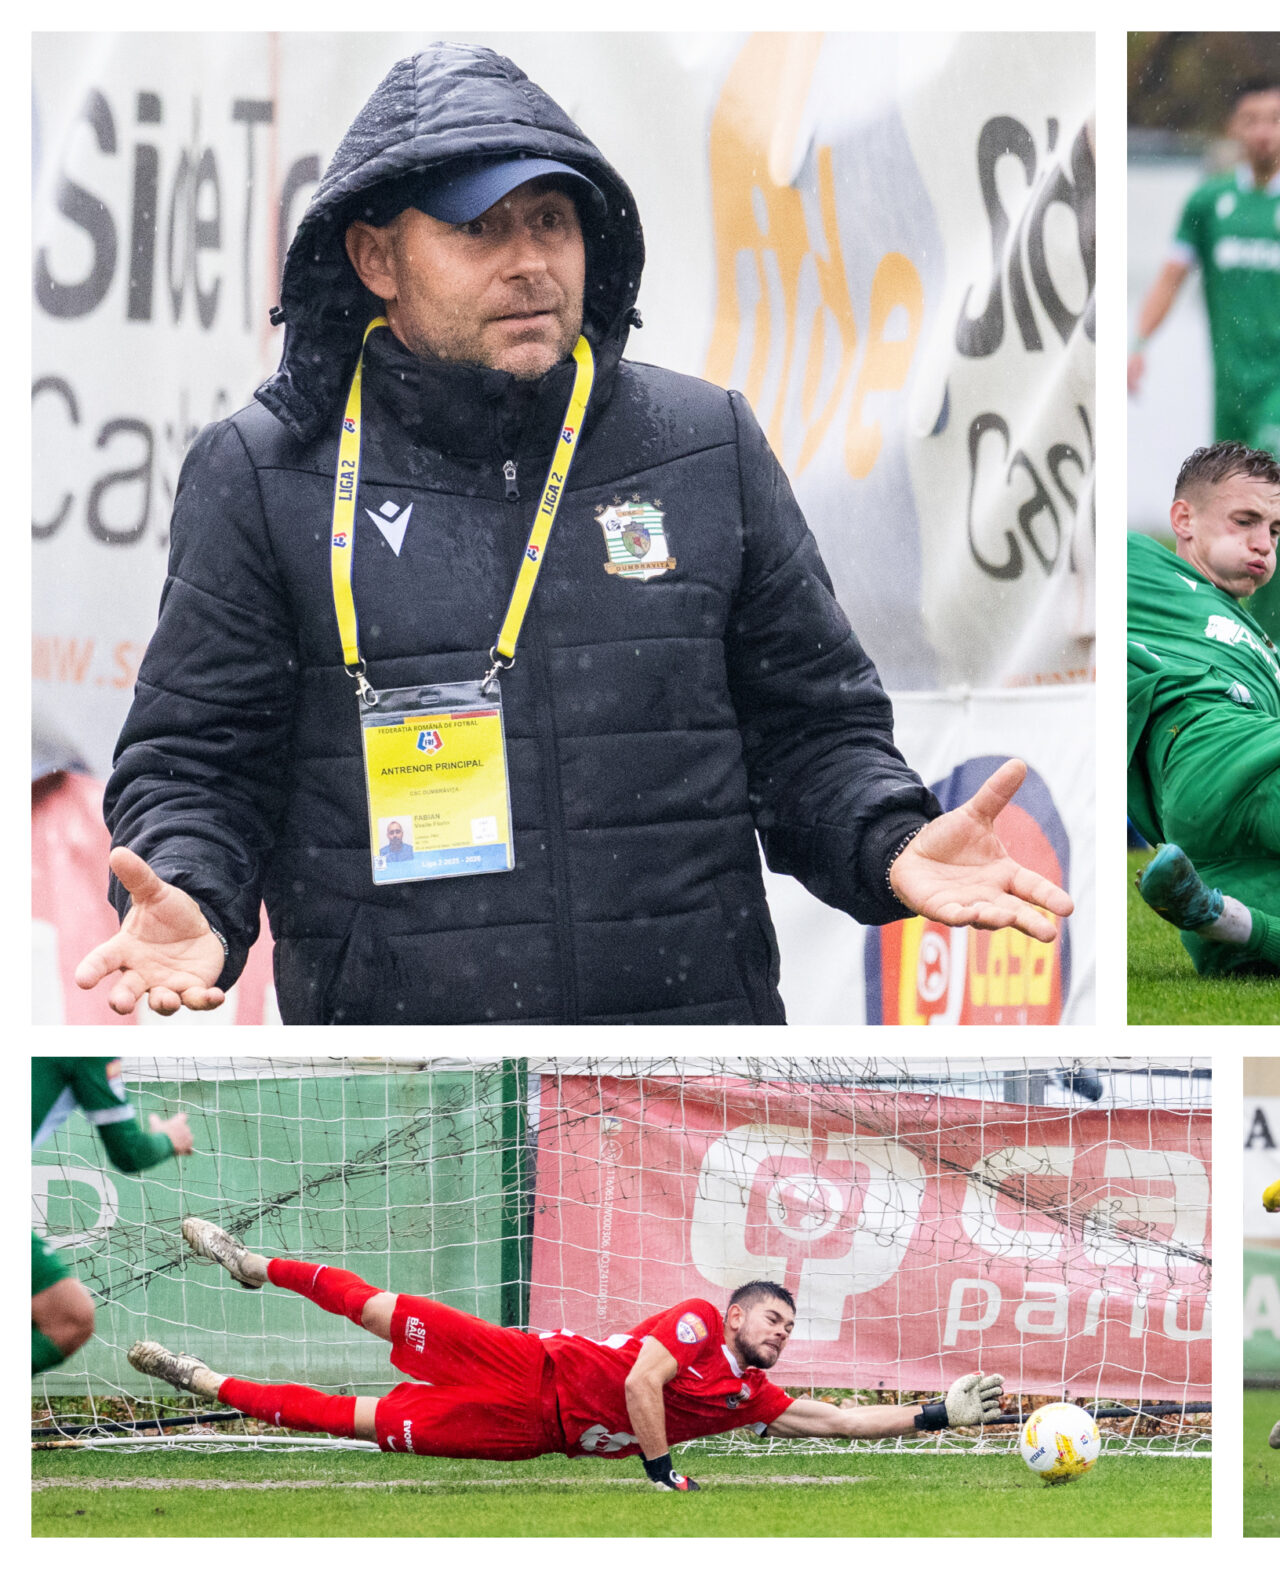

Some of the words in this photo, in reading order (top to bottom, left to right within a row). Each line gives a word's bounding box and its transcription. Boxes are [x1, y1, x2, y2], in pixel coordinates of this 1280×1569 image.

[342, 460, 355, 468] 2
[339, 471, 355, 501] LIGA
[541, 482, 563, 516] LIGA
[552, 472, 563, 483] 2
[453, 719, 479, 727] FOTBAL
[380, 764, 433, 776] ANTRENOR
[435, 759, 484, 771] PRINCIPAL
[414, 813, 440, 821] FABIAN
[416, 1328, 427, 1353] SITE
